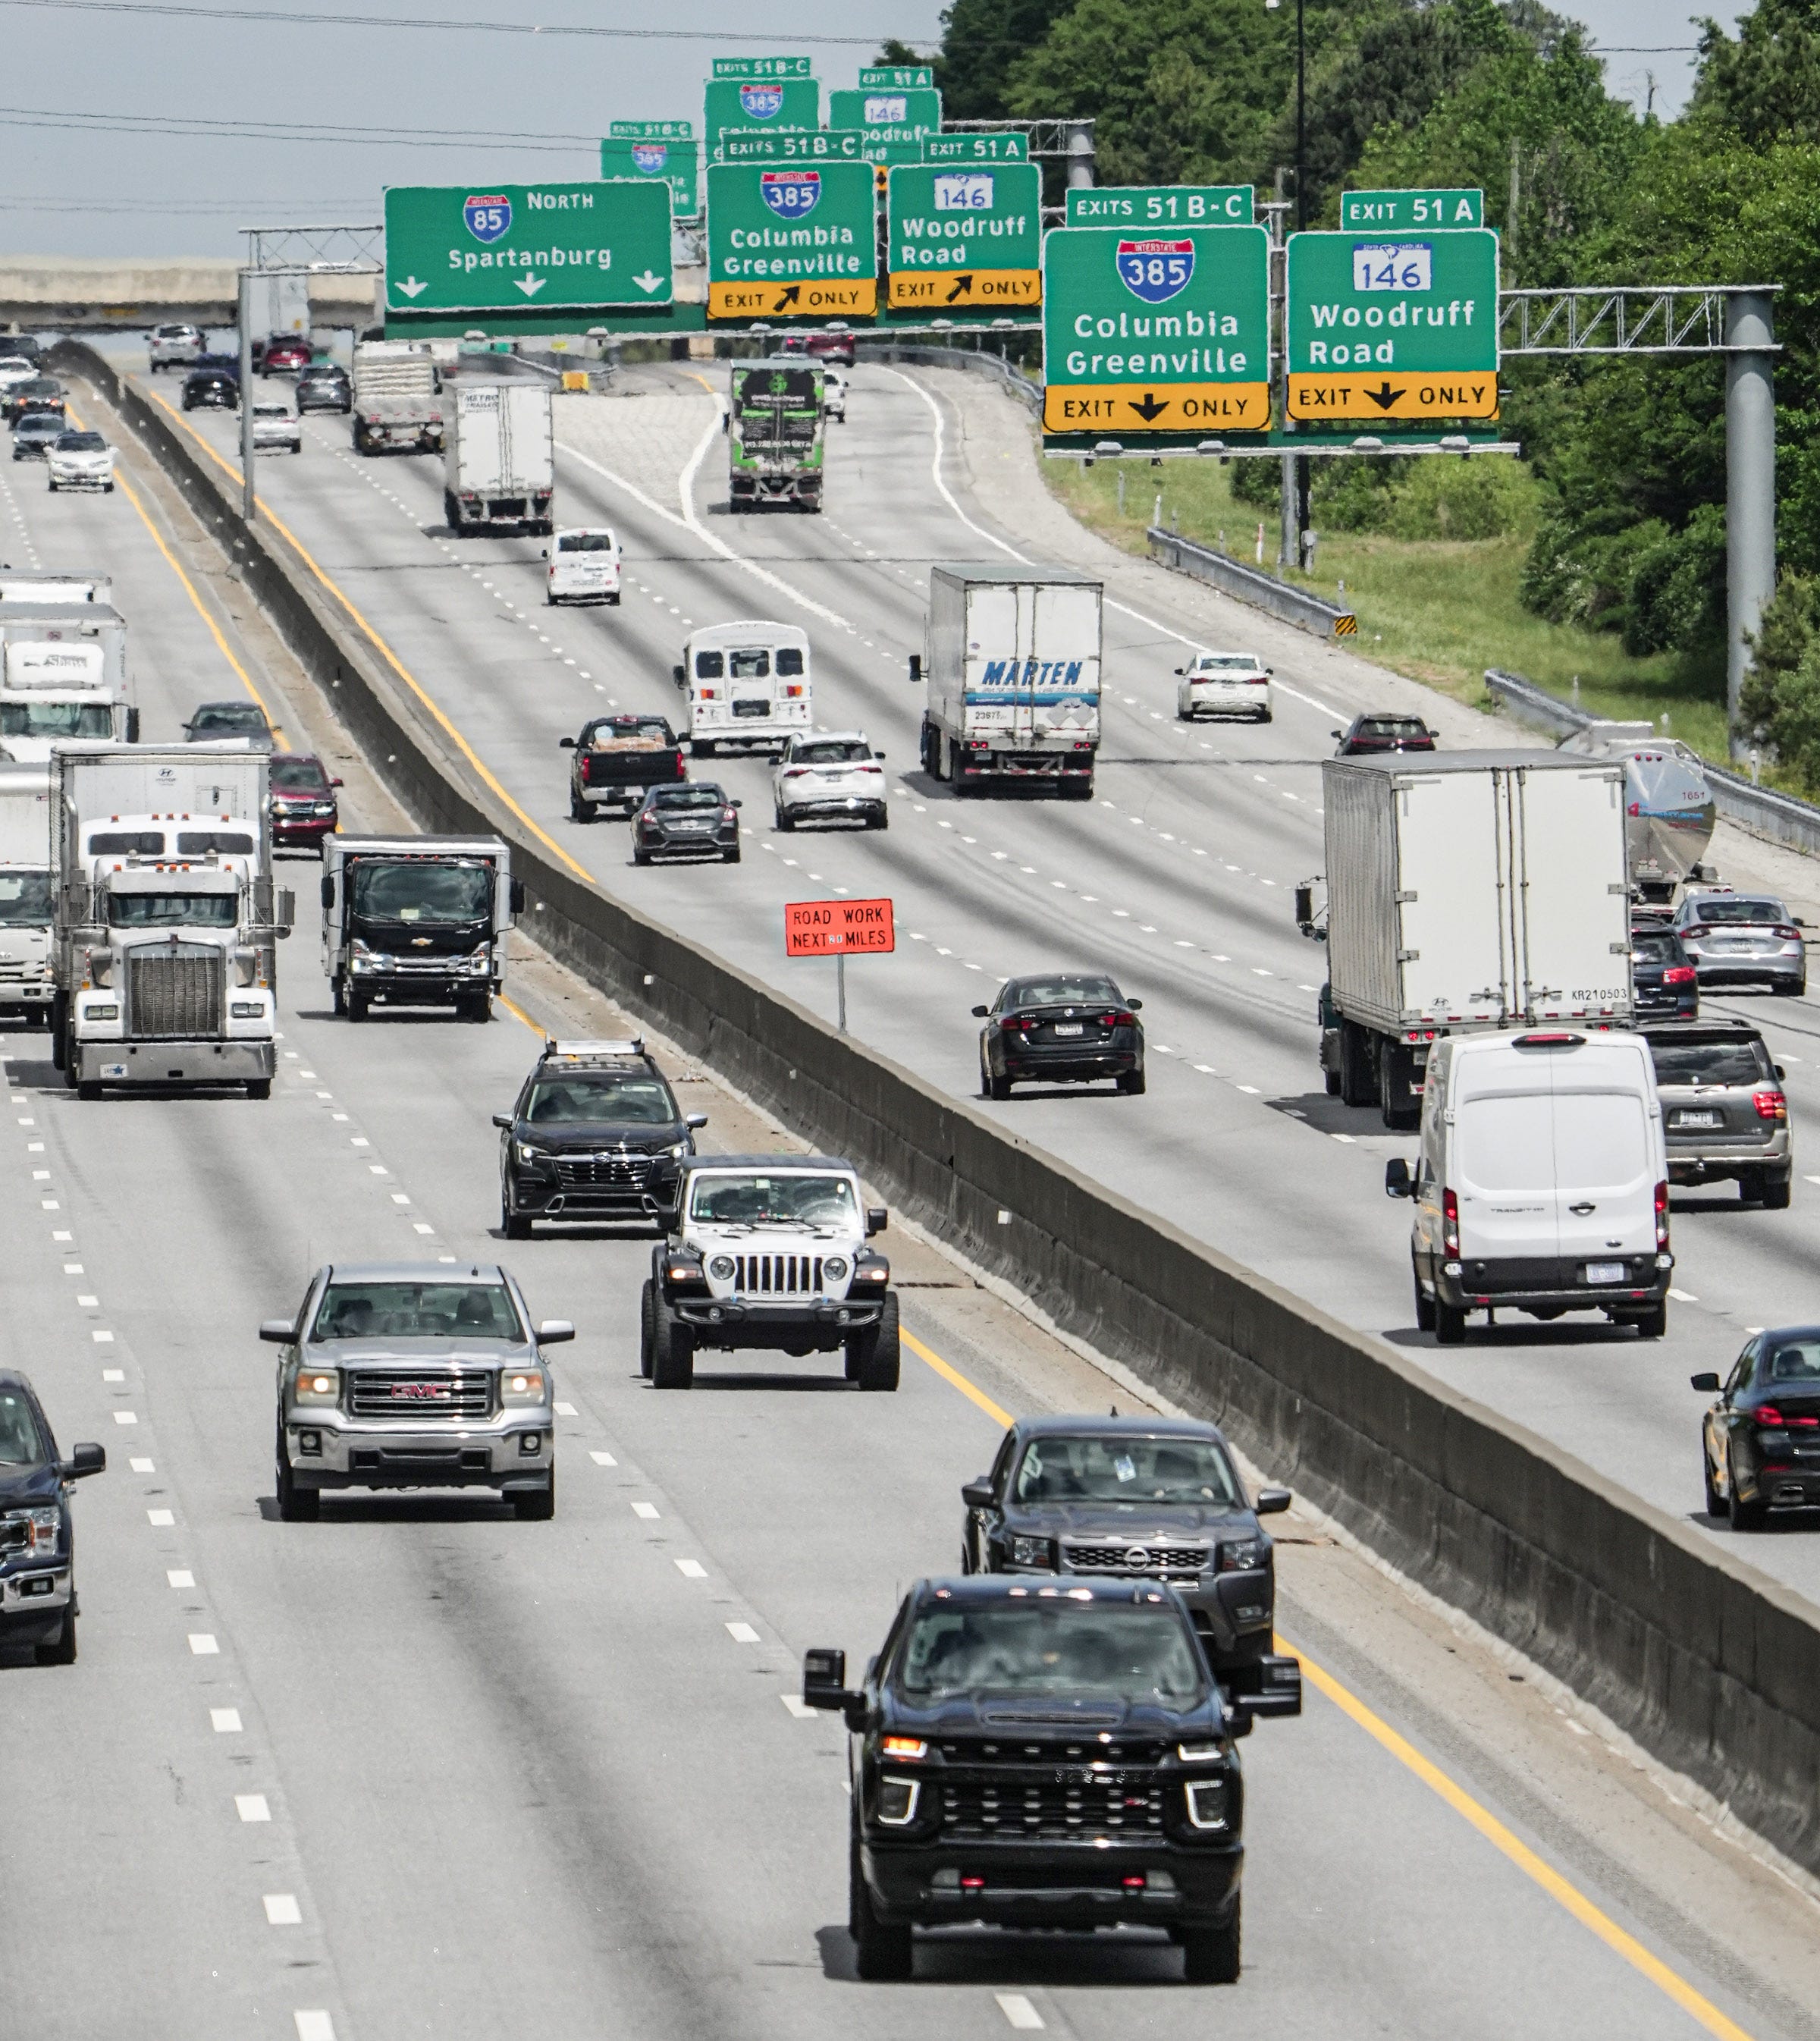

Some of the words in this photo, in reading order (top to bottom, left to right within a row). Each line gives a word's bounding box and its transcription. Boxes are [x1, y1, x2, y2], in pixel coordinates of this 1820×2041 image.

[746, 96, 779, 111] 385
[870, 107, 900, 121] 146
[730, 141, 774, 155] EXITS
[930, 143, 962, 156] EXIT
[974, 140, 998, 157] 51
[1006, 140, 1020, 157] A
[527, 193, 593, 210] NORTH
[770, 186, 814, 208] 385
[943, 187, 985, 209] 146
[1077, 199, 1133, 217] EXITS
[474, 209, 503, 231] 85
[1350, 203, 1396, 221] EXIT
[1413, 198, 1442, 221] 51
[1454, 198, 1473, 221] A
[730, 226, 854, 249] Columbia
[902, 215, 1026, 238] Woodruff
[902, 243, 967, 265] Road
[1135, 243, 1177, 252] INTERSTATE
[449, 246, 611, 273] Spartanburg
[724, 253, 861, 275] Greenville
[1128, 259, 1186, 286] 385
[1362, 262, 1420, 289] 146
[725, 294, 764, 307] EXIT
[809, 291, 859, 306] ONLY
[896, 283, 935, 298] EXIT
[982, 281, 1033, 296] ONLY
[1074, 311, 1239, 338] Columbia
[1310, 300, 1475, 328] Woodruff
[1066, 347, 1247, 375] Greenville
[1310, 339, 1395, 365] Road
[1300, 388, 1351, 407] EXIT
[1420, 386, 1485, 405] ONLY
[1064, 400, 1115, 418] EXIT
[1183, 398, 1247, 417] ONLY
[982, 661, 1083, 686] MARTEN
[793, 909, 831, 925] ROAD
[843, 907, 884, 924] WORK
[792, 932, 827, 949] NEXT
[846, 930, 886, 947] MILES
[1572, 988, 1627, 1000] KR210503
[391, 1383, 451, 1399] GMC
